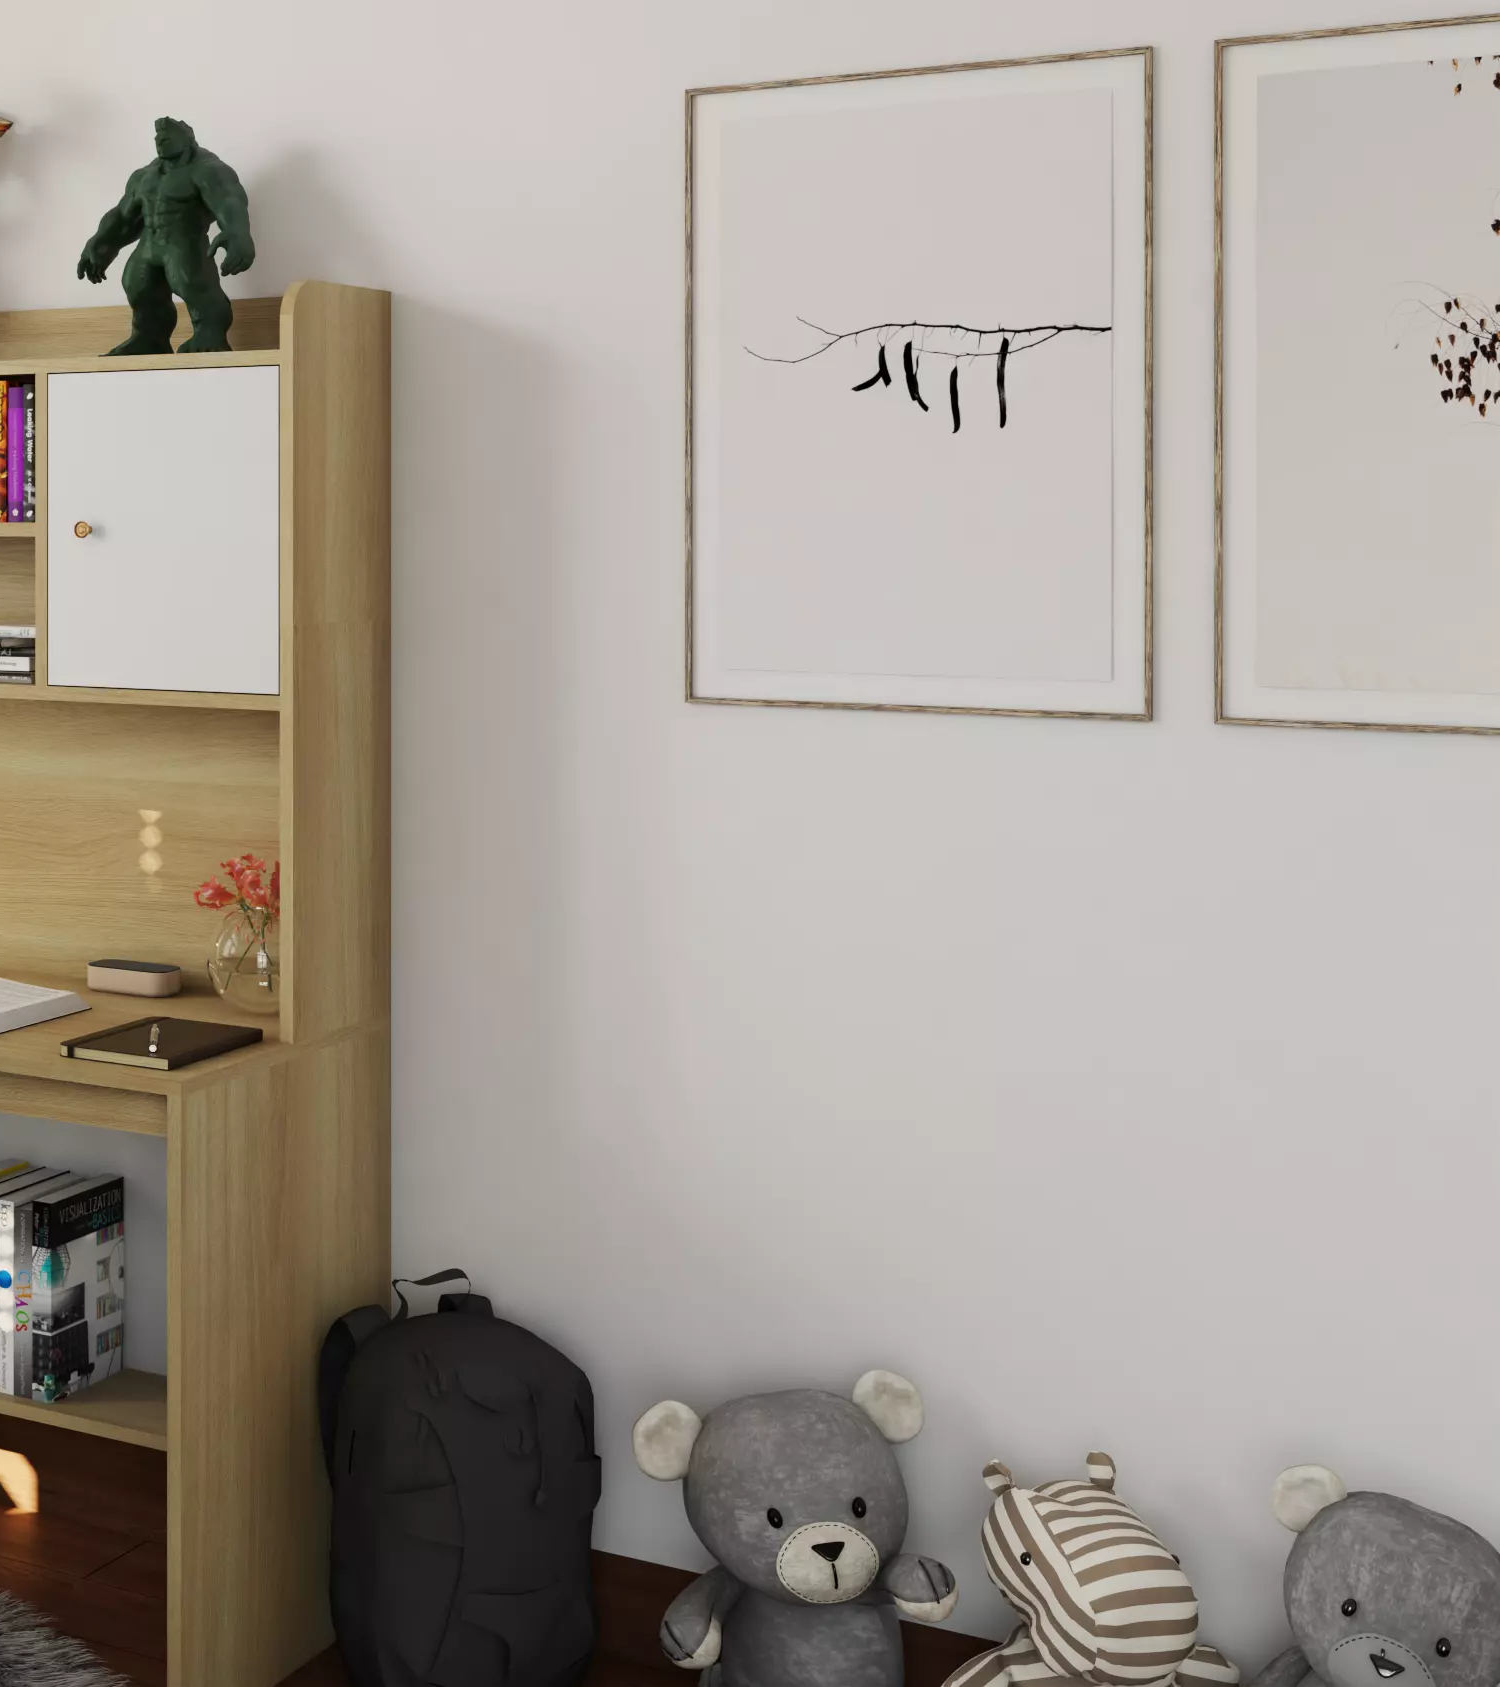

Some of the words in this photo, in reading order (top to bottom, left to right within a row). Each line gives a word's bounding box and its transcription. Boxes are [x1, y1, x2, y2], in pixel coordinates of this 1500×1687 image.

[25, 408, 33, 437] Leaking
[59, 1187, 122, 1225] VISUALIZATION
[92, 1204, 122, 1229] BASICS
[14, 1269, 32, 1333] CHAOS
